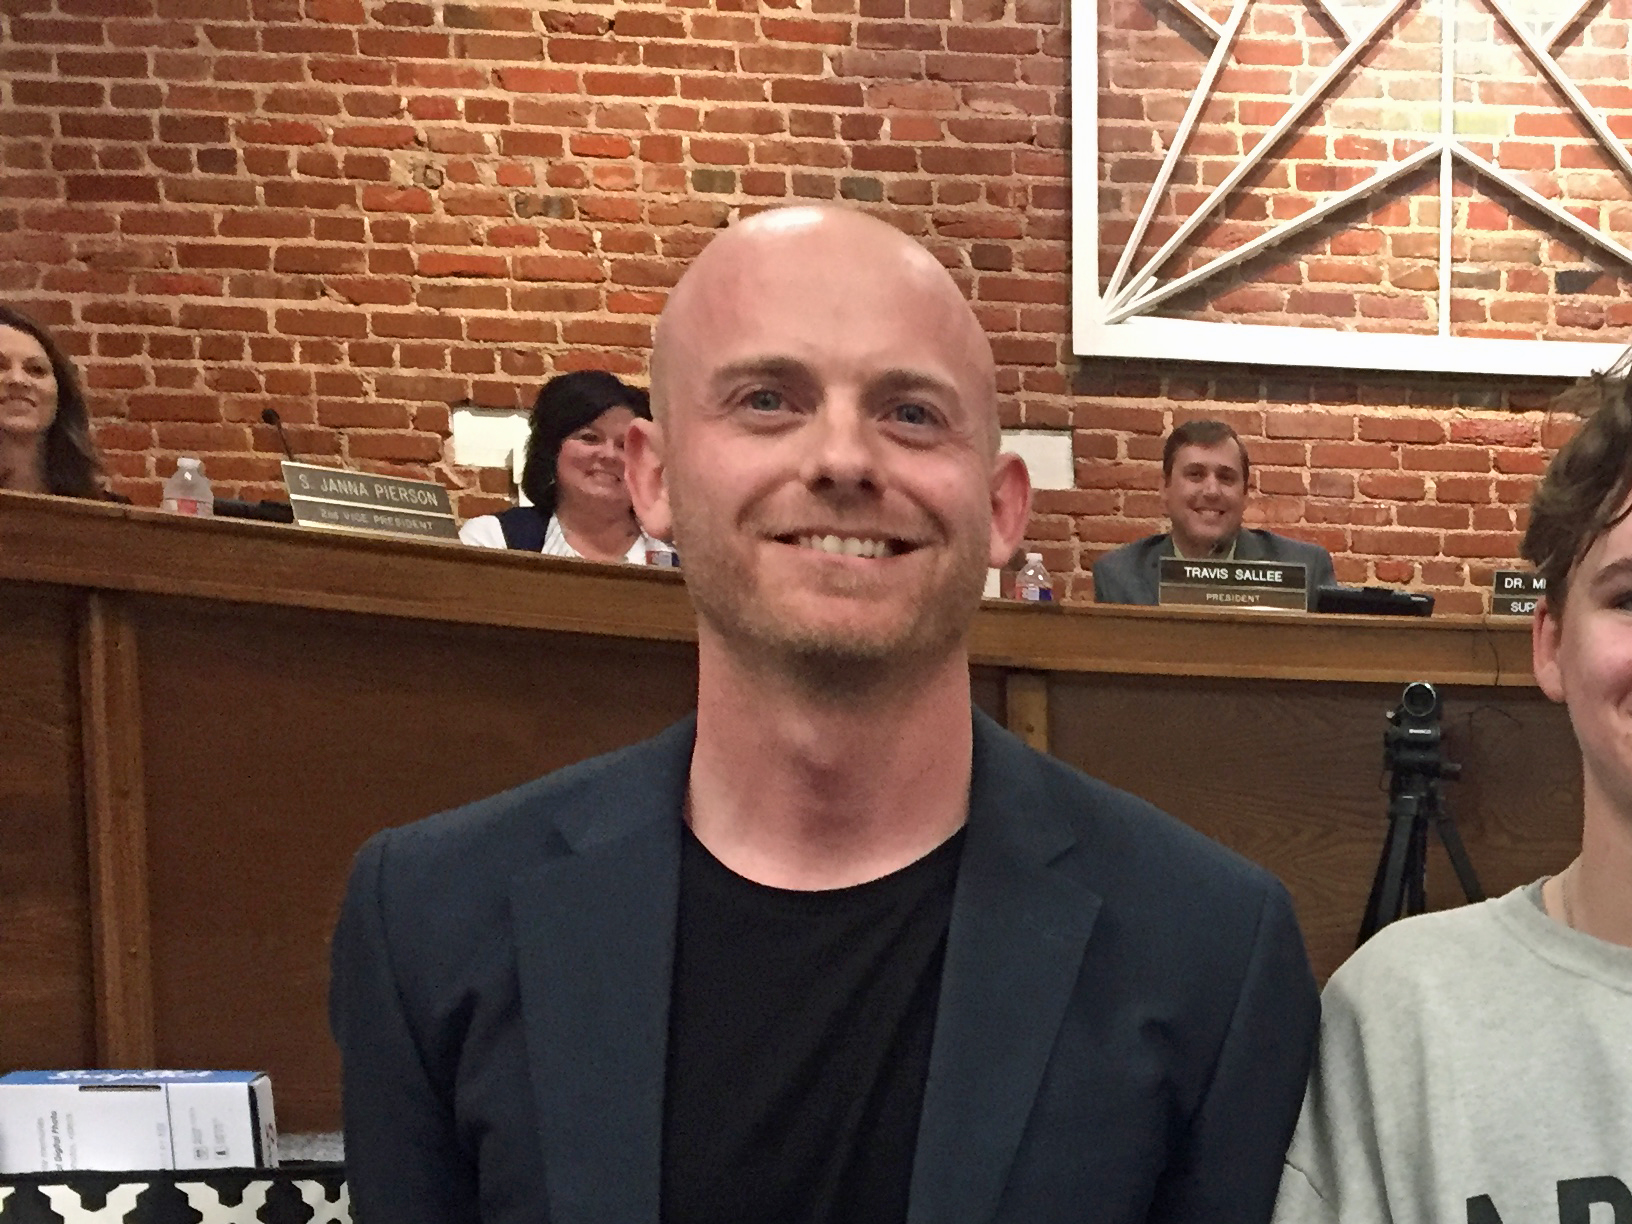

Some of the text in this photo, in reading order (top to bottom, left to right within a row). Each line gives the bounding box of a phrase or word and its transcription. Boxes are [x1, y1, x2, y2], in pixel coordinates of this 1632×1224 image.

[320, 478, 369, 497] JANNA
[374, 483, 439, 507] PIERSON
[343, 512, 369, 524] VICE
[374, 515, 433, 531] PRESIDENT
[1184, 566, 1283, 582] TRAVIS SALLEE
[1206, 593, 1260, 604] PRESIDENT
